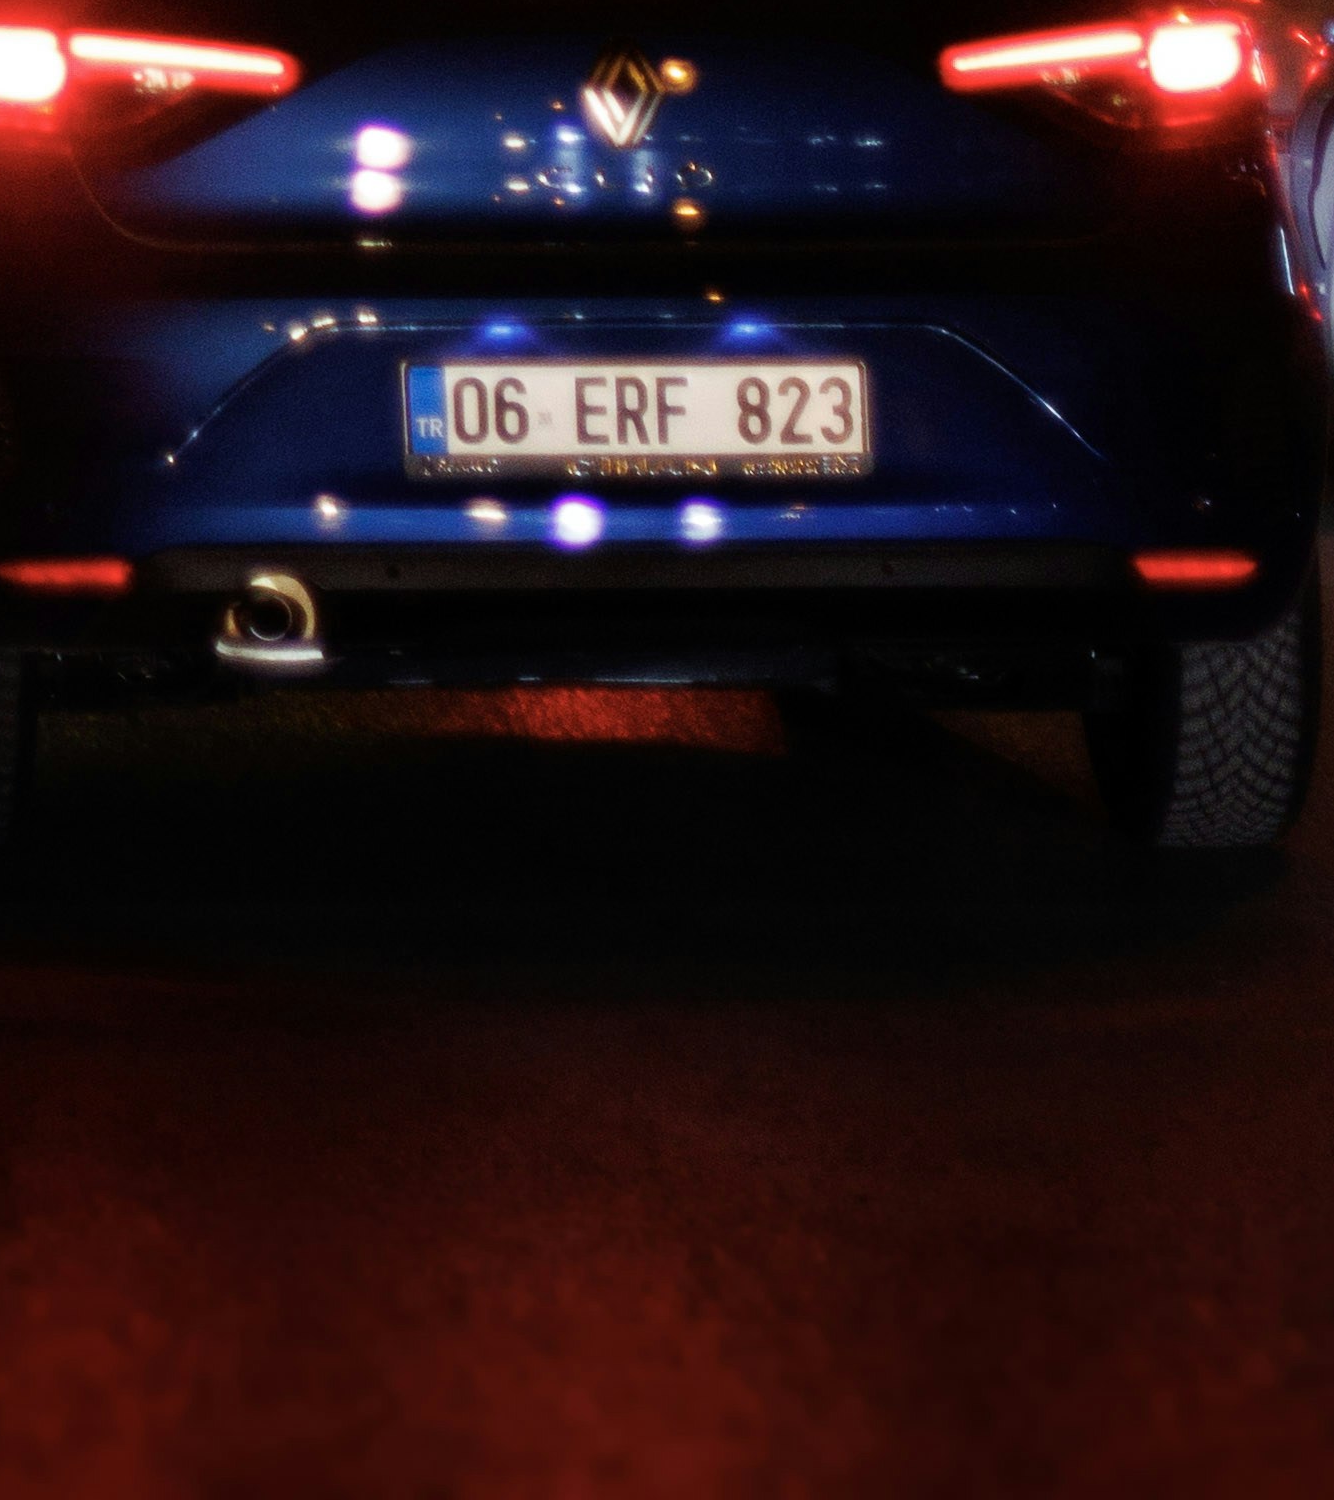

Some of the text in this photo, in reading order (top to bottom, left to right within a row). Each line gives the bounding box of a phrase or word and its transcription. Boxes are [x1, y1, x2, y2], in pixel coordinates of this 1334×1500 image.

[417, 376, 855, 445] TR 06 ERF 823
